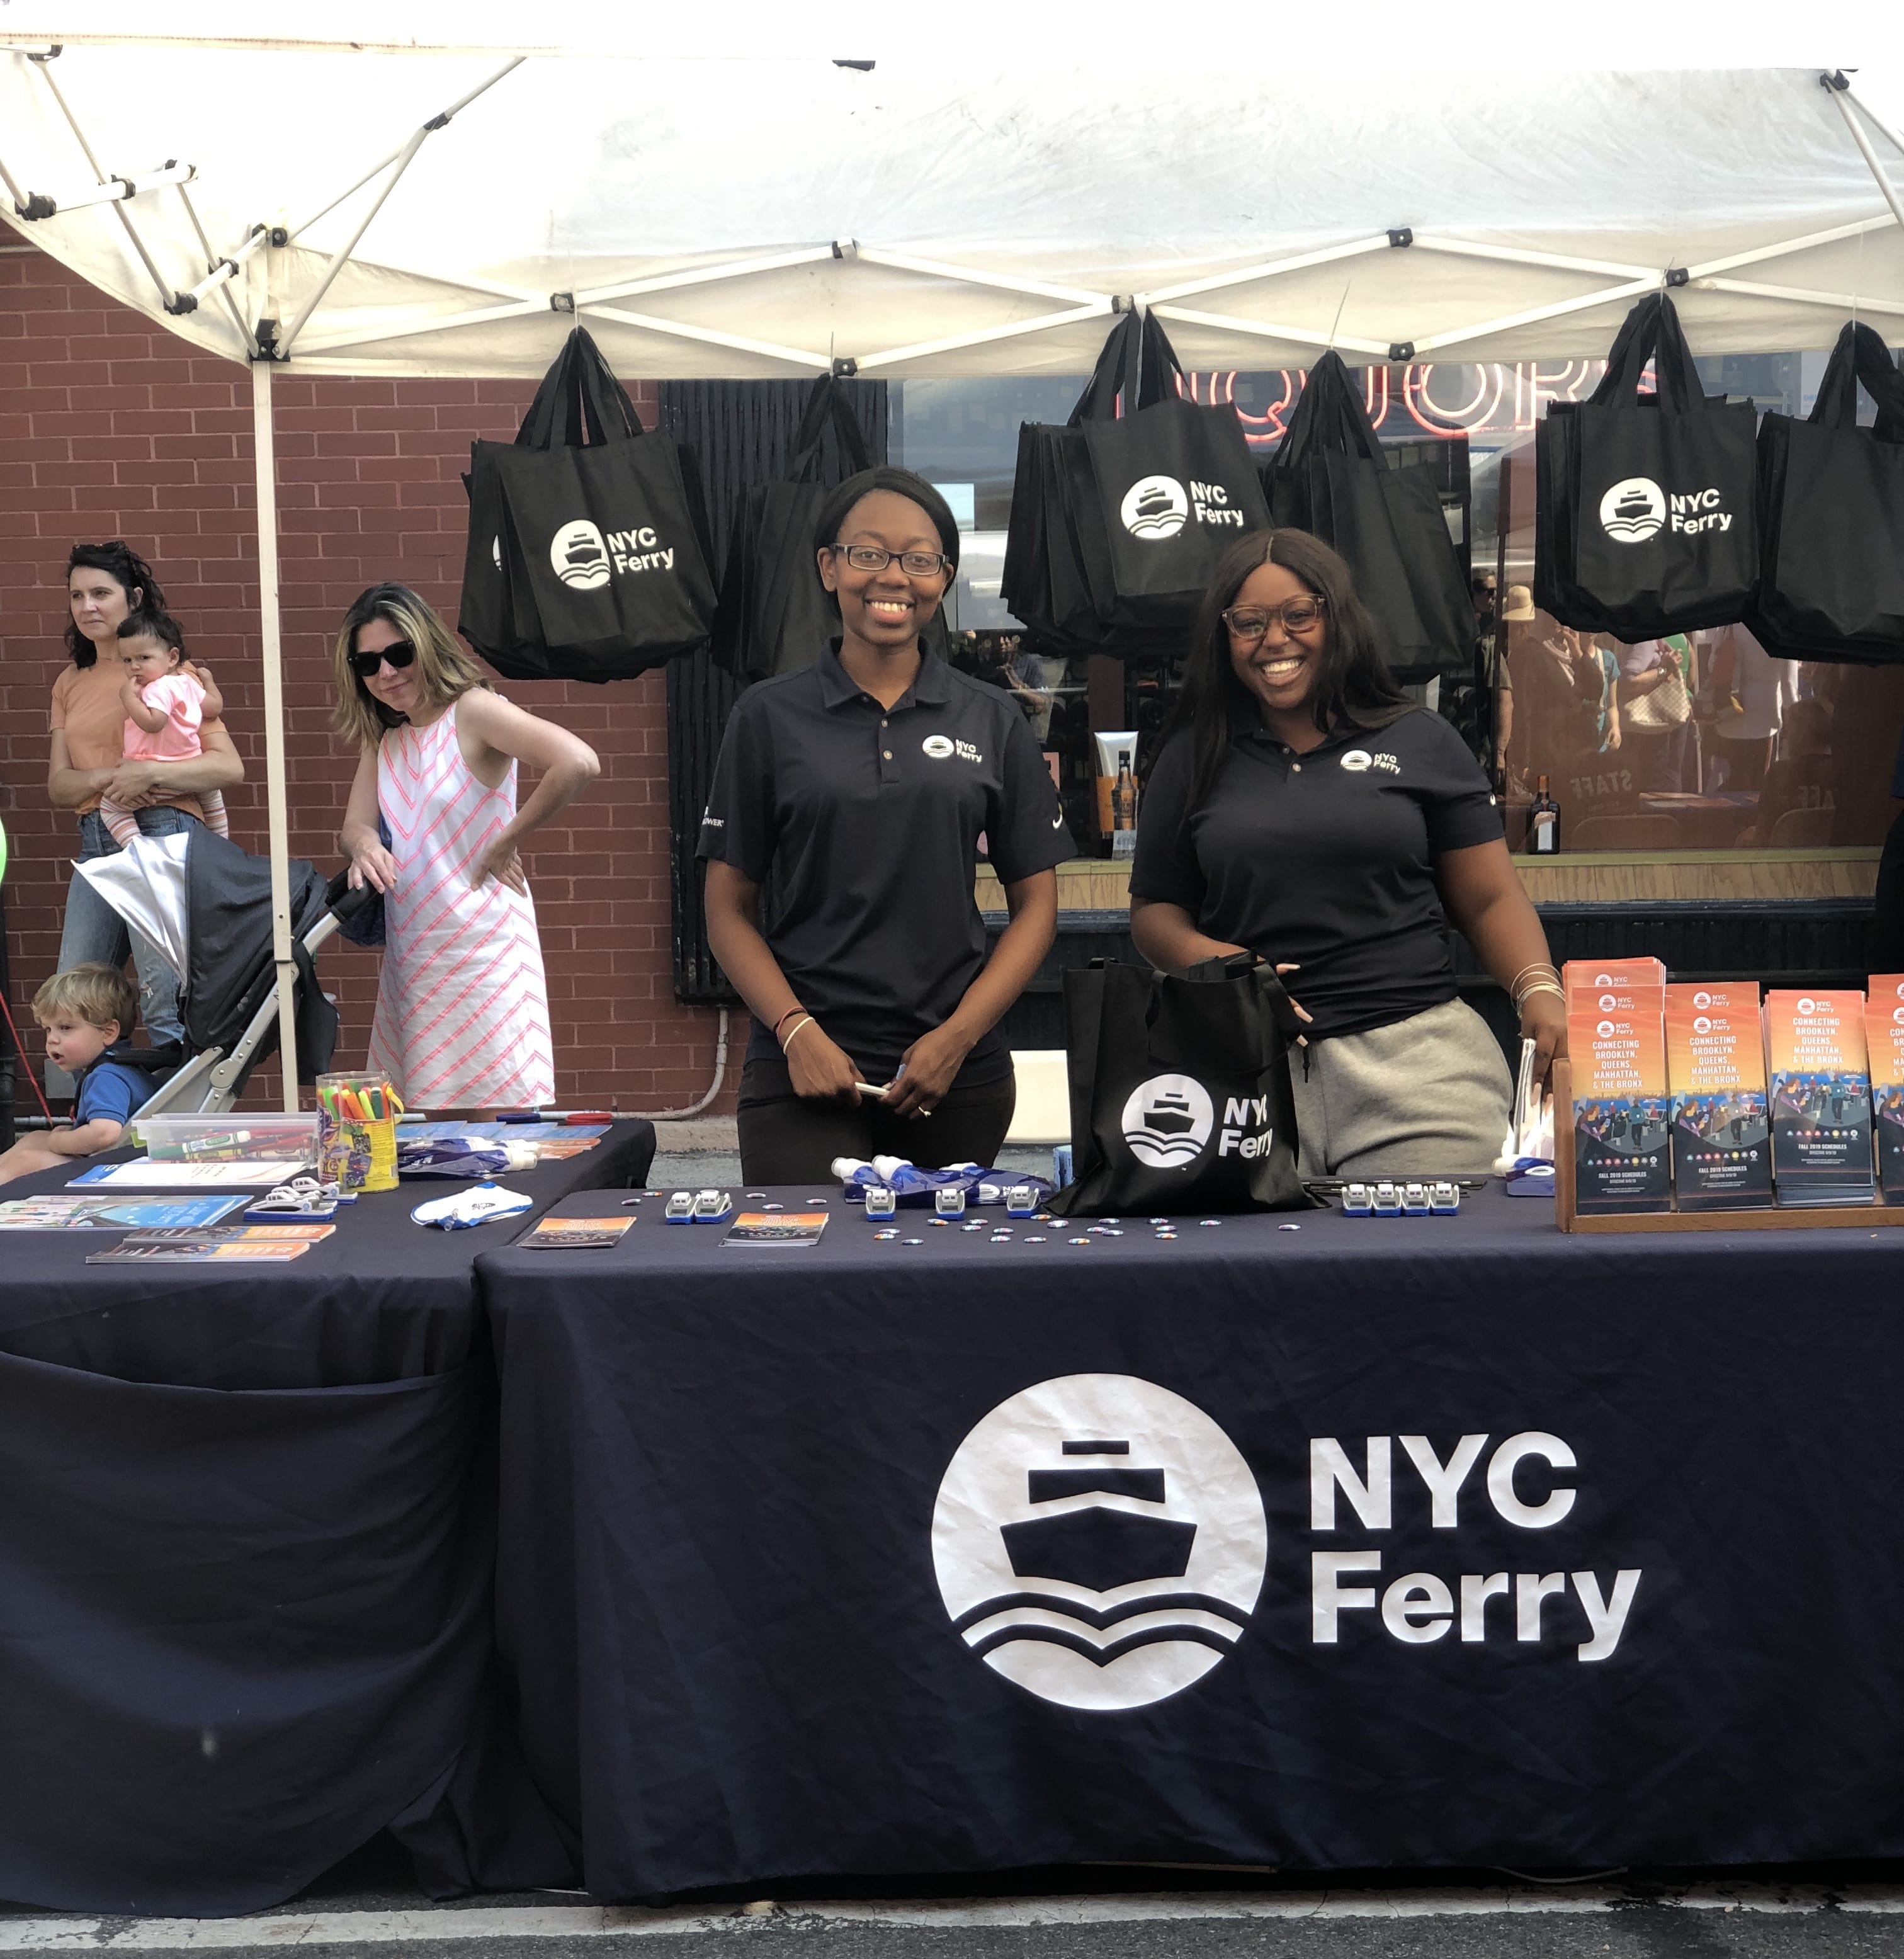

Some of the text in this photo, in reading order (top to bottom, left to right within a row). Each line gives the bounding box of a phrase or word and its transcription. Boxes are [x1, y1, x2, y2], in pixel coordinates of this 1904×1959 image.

[1189, 480, 1227, 504] NYC
[1670, 489, 1720, 513] NYC
[1194, 503, 1244, 528] Ferry
[1672, 513, 1732, 534] Ferry
[606, 526, 657, 553] NYC
[613, 547, 674, 575] Ferry
[956, 739, 977, 753] NYC
[956, 747, 982, 763] Ferry
[1374, 753, 1397, 763] NYC
[1373, 760, 1400, 775] Ferry
[1793, 1018, 1840, 1026] CONNECTING
[1592, 1040, 1640, 1049] CONNECTING
[1689, 1036, 1737, 1045] CONNECTING
[1616, 1079, 1642, 1087] BRONX
[1714, 1075, 1740, 1084] BRONX
[1218, 1128, 1272, 1159] Ferry
[1310, 1431, 1577, 1530] NYC
[1312, 1550, 1642, 1662] Ferry
